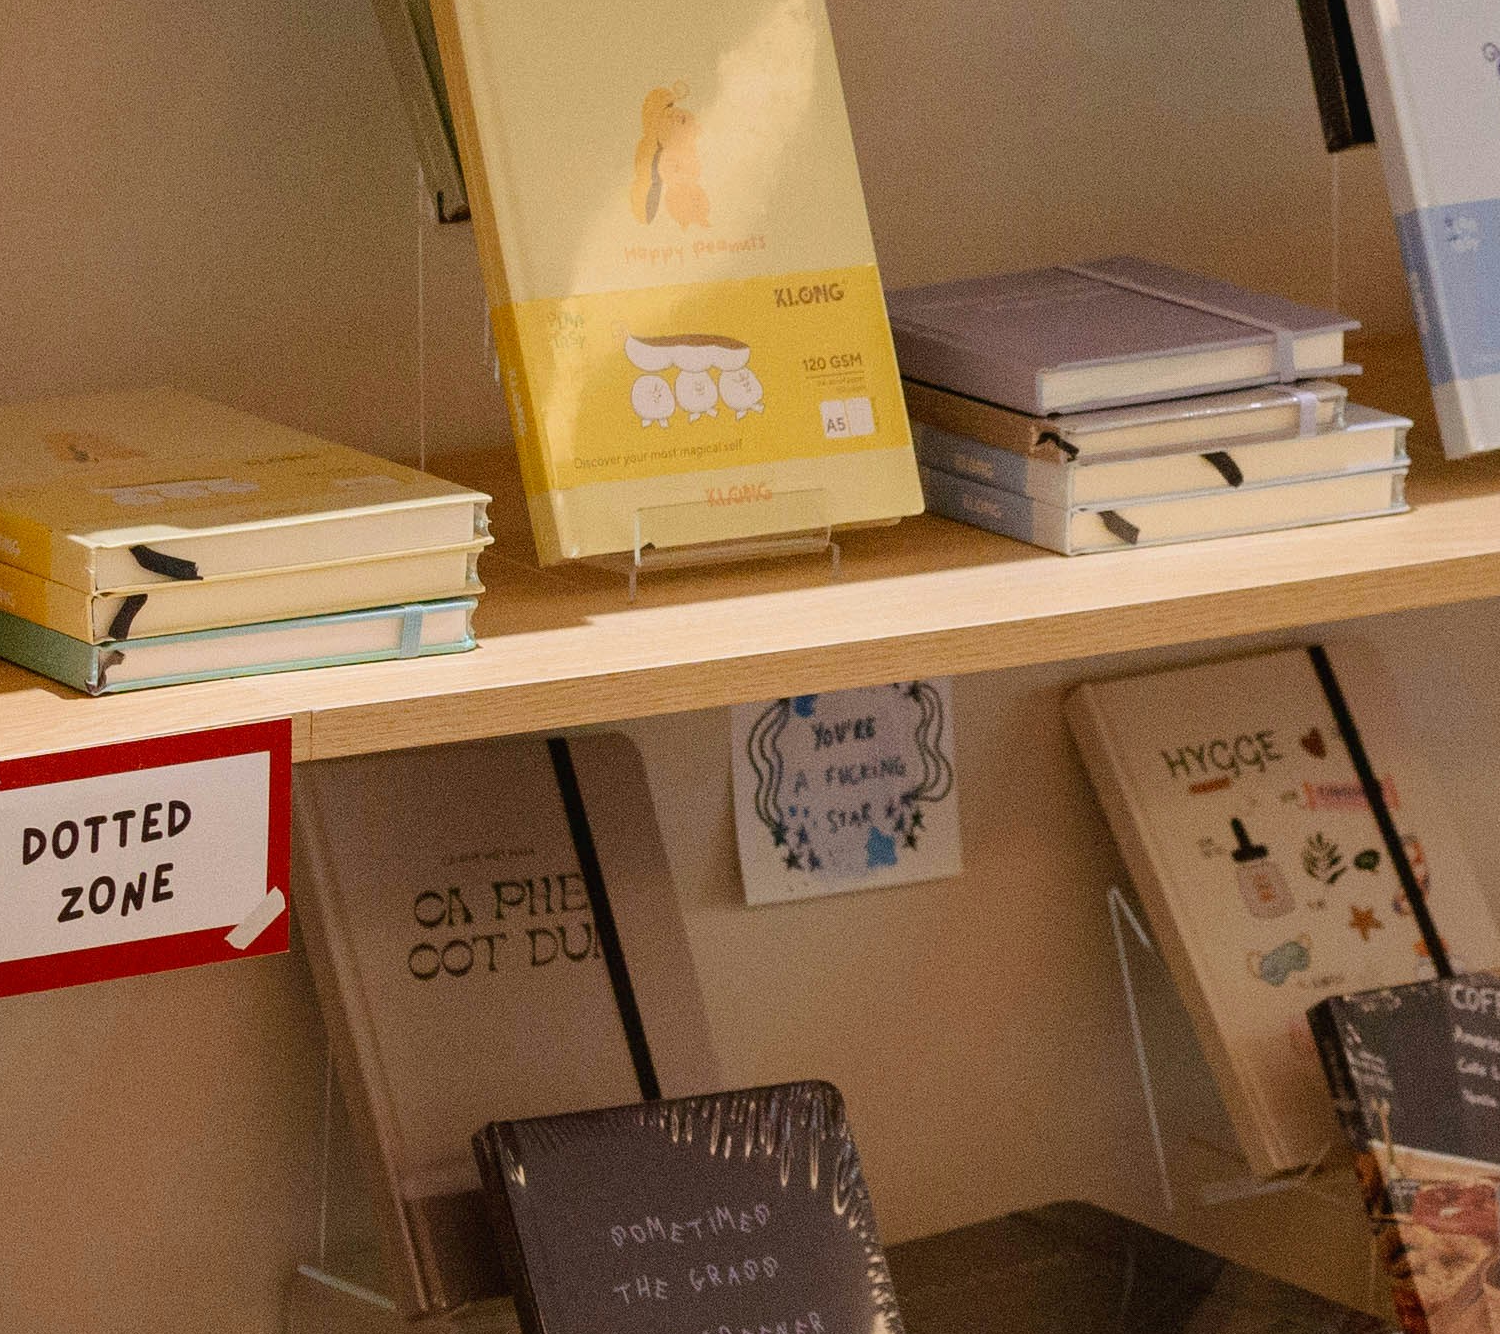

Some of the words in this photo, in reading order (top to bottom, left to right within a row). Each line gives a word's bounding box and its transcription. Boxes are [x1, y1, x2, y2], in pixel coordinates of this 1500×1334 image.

[802, 356, 827, 372] 120
[829, 352, 863, 369] GSM
[826, 417, 847, 433] A5
[573, 454, 621, 471] Discover
[623, 451, 649, 467] your
[650, 447, 678, 461] most
[22, 799, 192, 866] DOTTED
[56, 861, 174, 923] ZONE
[613, 1273, 669, 1305] THE
[688, 1255, 779, 1292] GRASS
